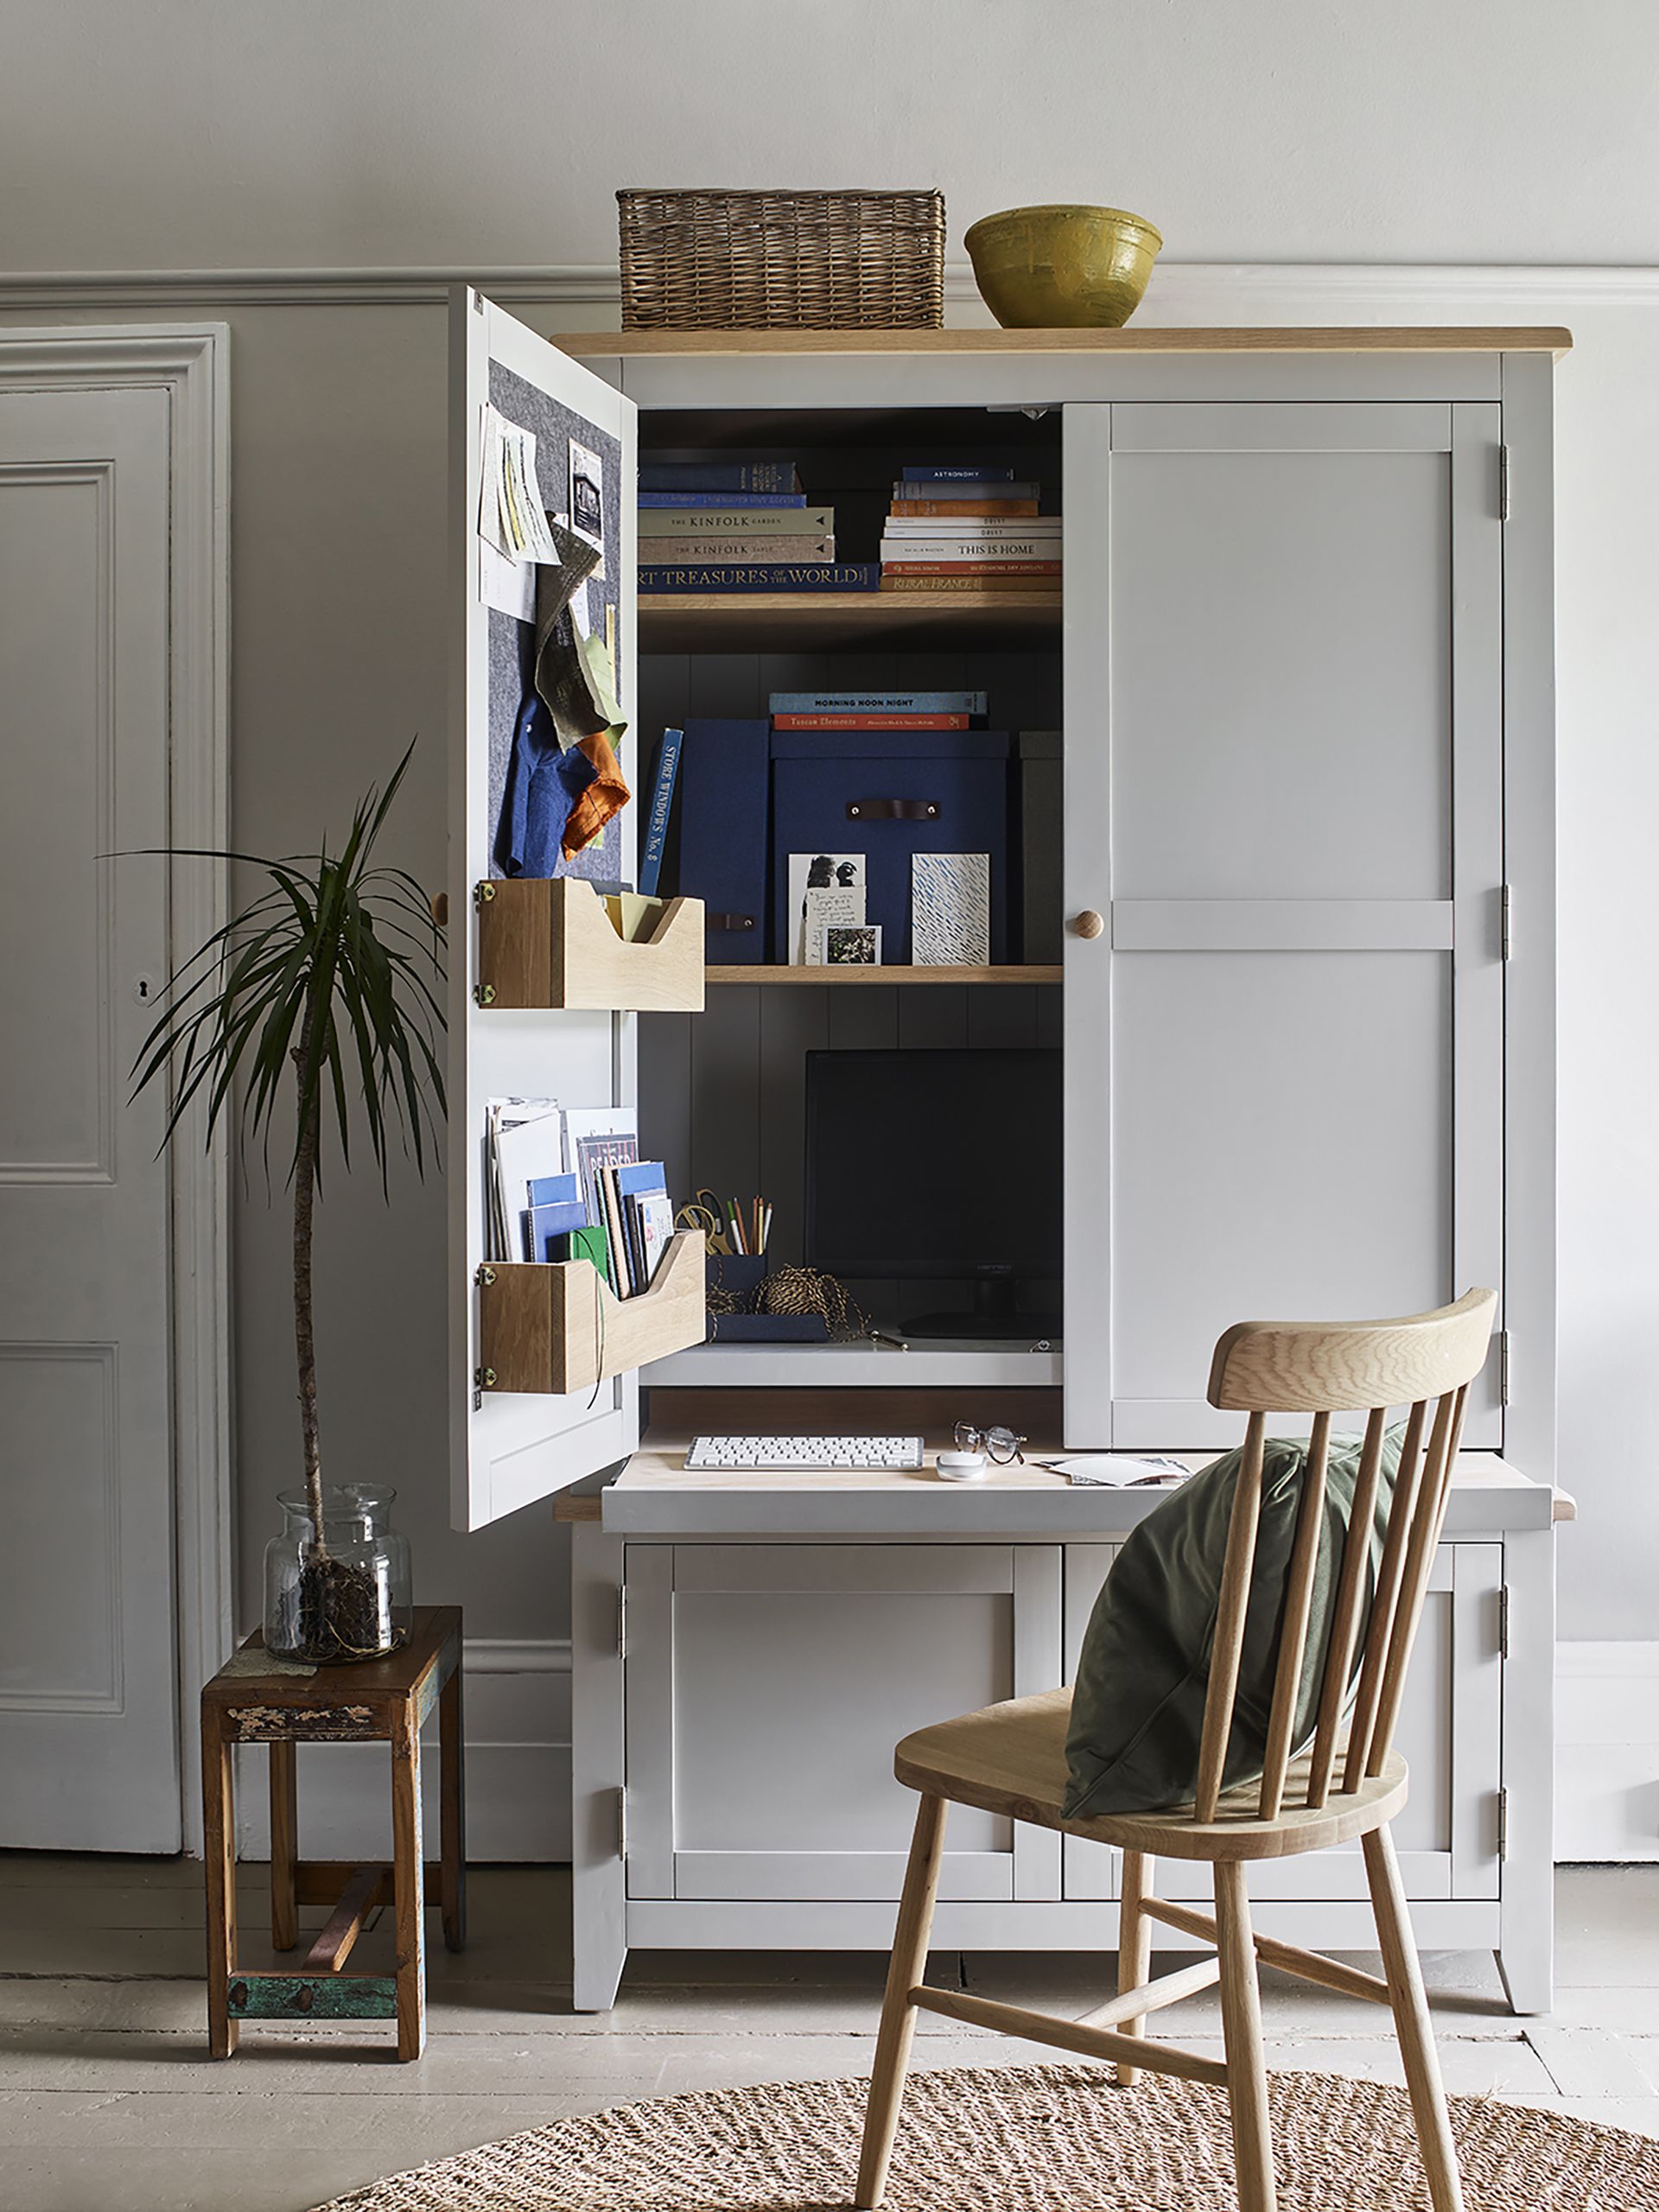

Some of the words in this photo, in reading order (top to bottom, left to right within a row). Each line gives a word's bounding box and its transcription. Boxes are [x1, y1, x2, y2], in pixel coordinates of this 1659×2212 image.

[690, 517, 749, 527] KINFOLK
[694, 545, 748, 554] KINFOLK
[957, 545, 985, 555] THIS
[988, 545, 998, 555] IS
[1000, 544, 1035, 555] HOME
[662, 569, 768, 586] TREASURES
[788, 568, 858, 584] WORLD
[887, 698, 914, 707] NIGHT
[791, 717, 818, 726] Tuscan
[820, 717, 856, 726] Elements
[662, 746, 677, 780] STORE
[652, 782, 671, 833] WINDOWS
[649, 836, 661, 853] No.
